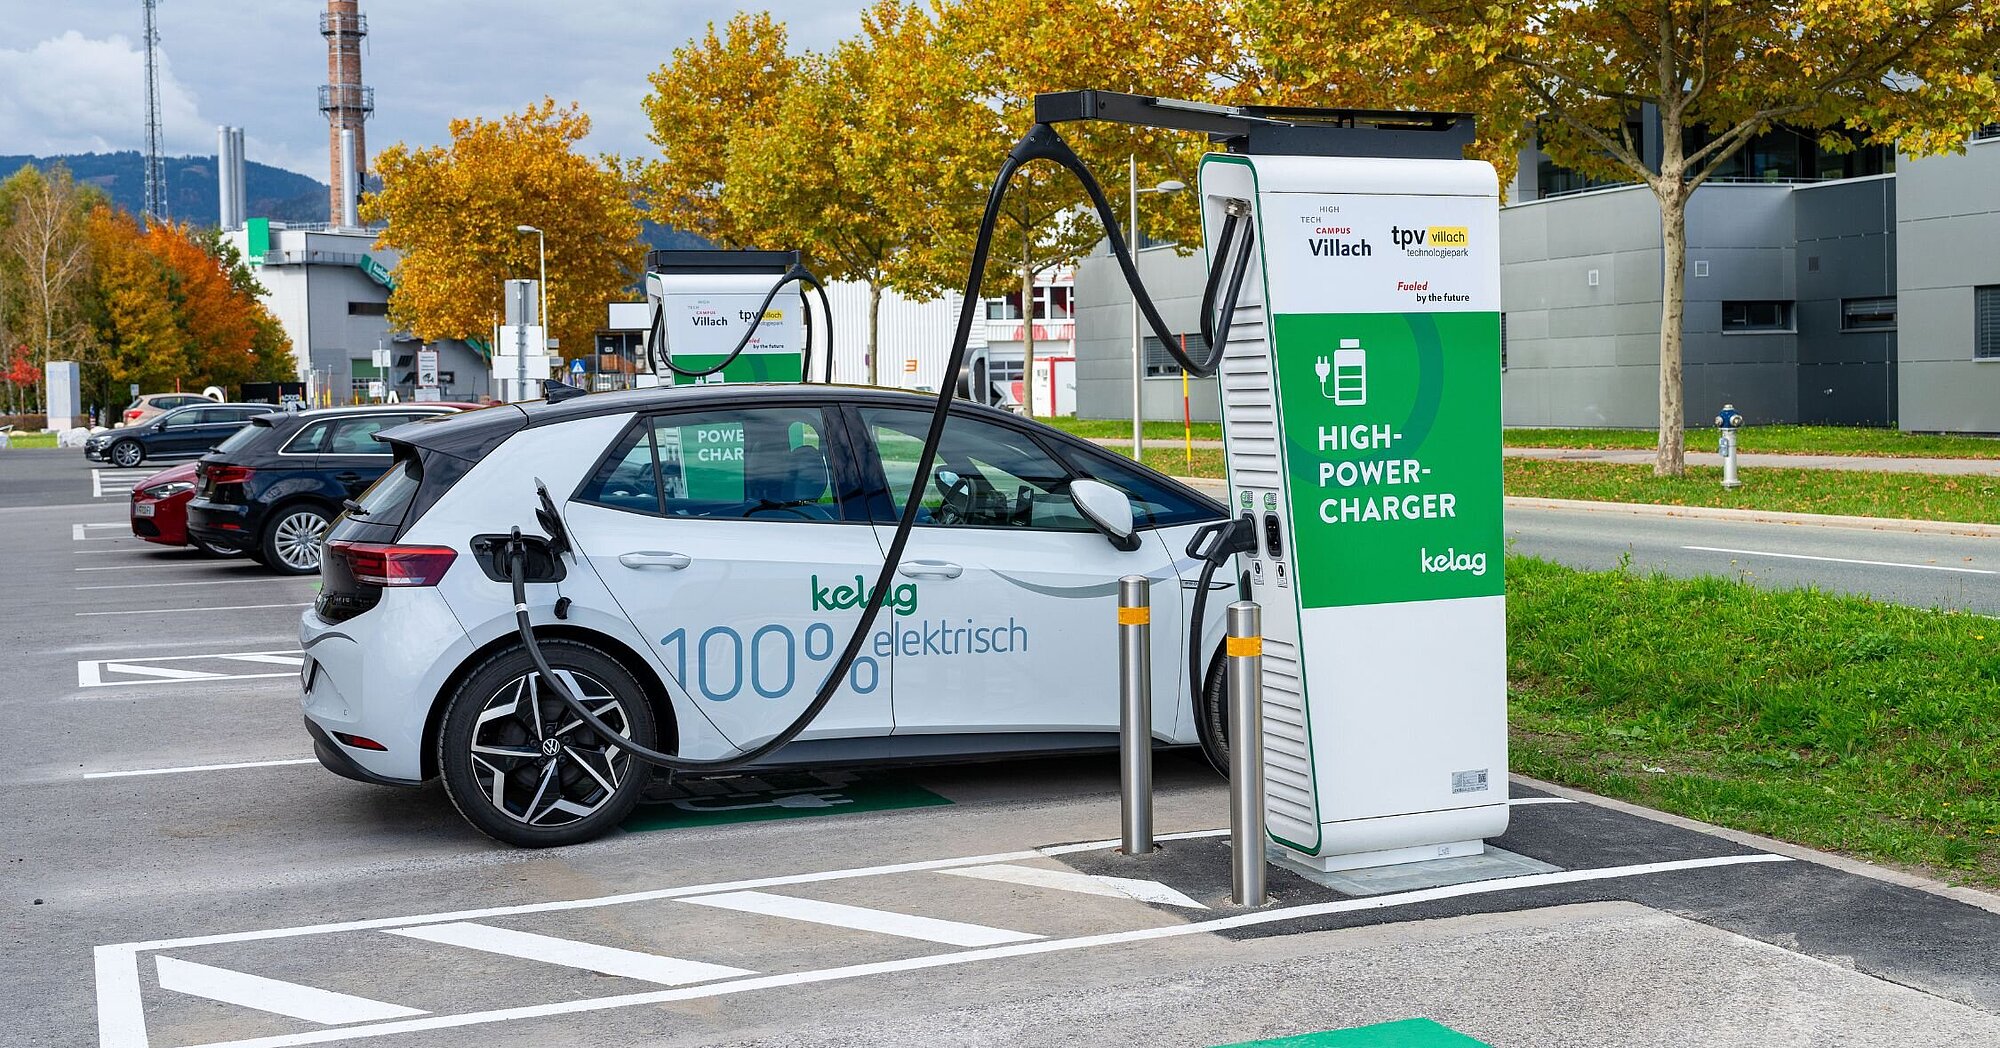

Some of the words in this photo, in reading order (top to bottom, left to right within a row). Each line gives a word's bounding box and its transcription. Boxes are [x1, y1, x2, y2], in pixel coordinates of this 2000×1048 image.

[1308, 238, 1372, 256] Villach
[1391, 225, 1426, 250] tpv
[1431, 231, 1465, 243] villach
[1406, 248, 1469, 259] technologiepark
[1397, 281, 1428, 291] Fueled
[1416, 293, 1427, 304] by
[1428, 293, 1442, 302] the
[1443, 292, 1470, 302] future
[691, 316, 728, 326] Villach
[1318, 424, 1403, 451] HIGH-
[1319, 459, 1431, 487] POWER-
[1319, 493, 1456, 524] CHARGER
[1421, 547, 1487, 576] kelag
[660, 622, 879, 702] 100%
[873, 617, 1028, 658] elektrisch
